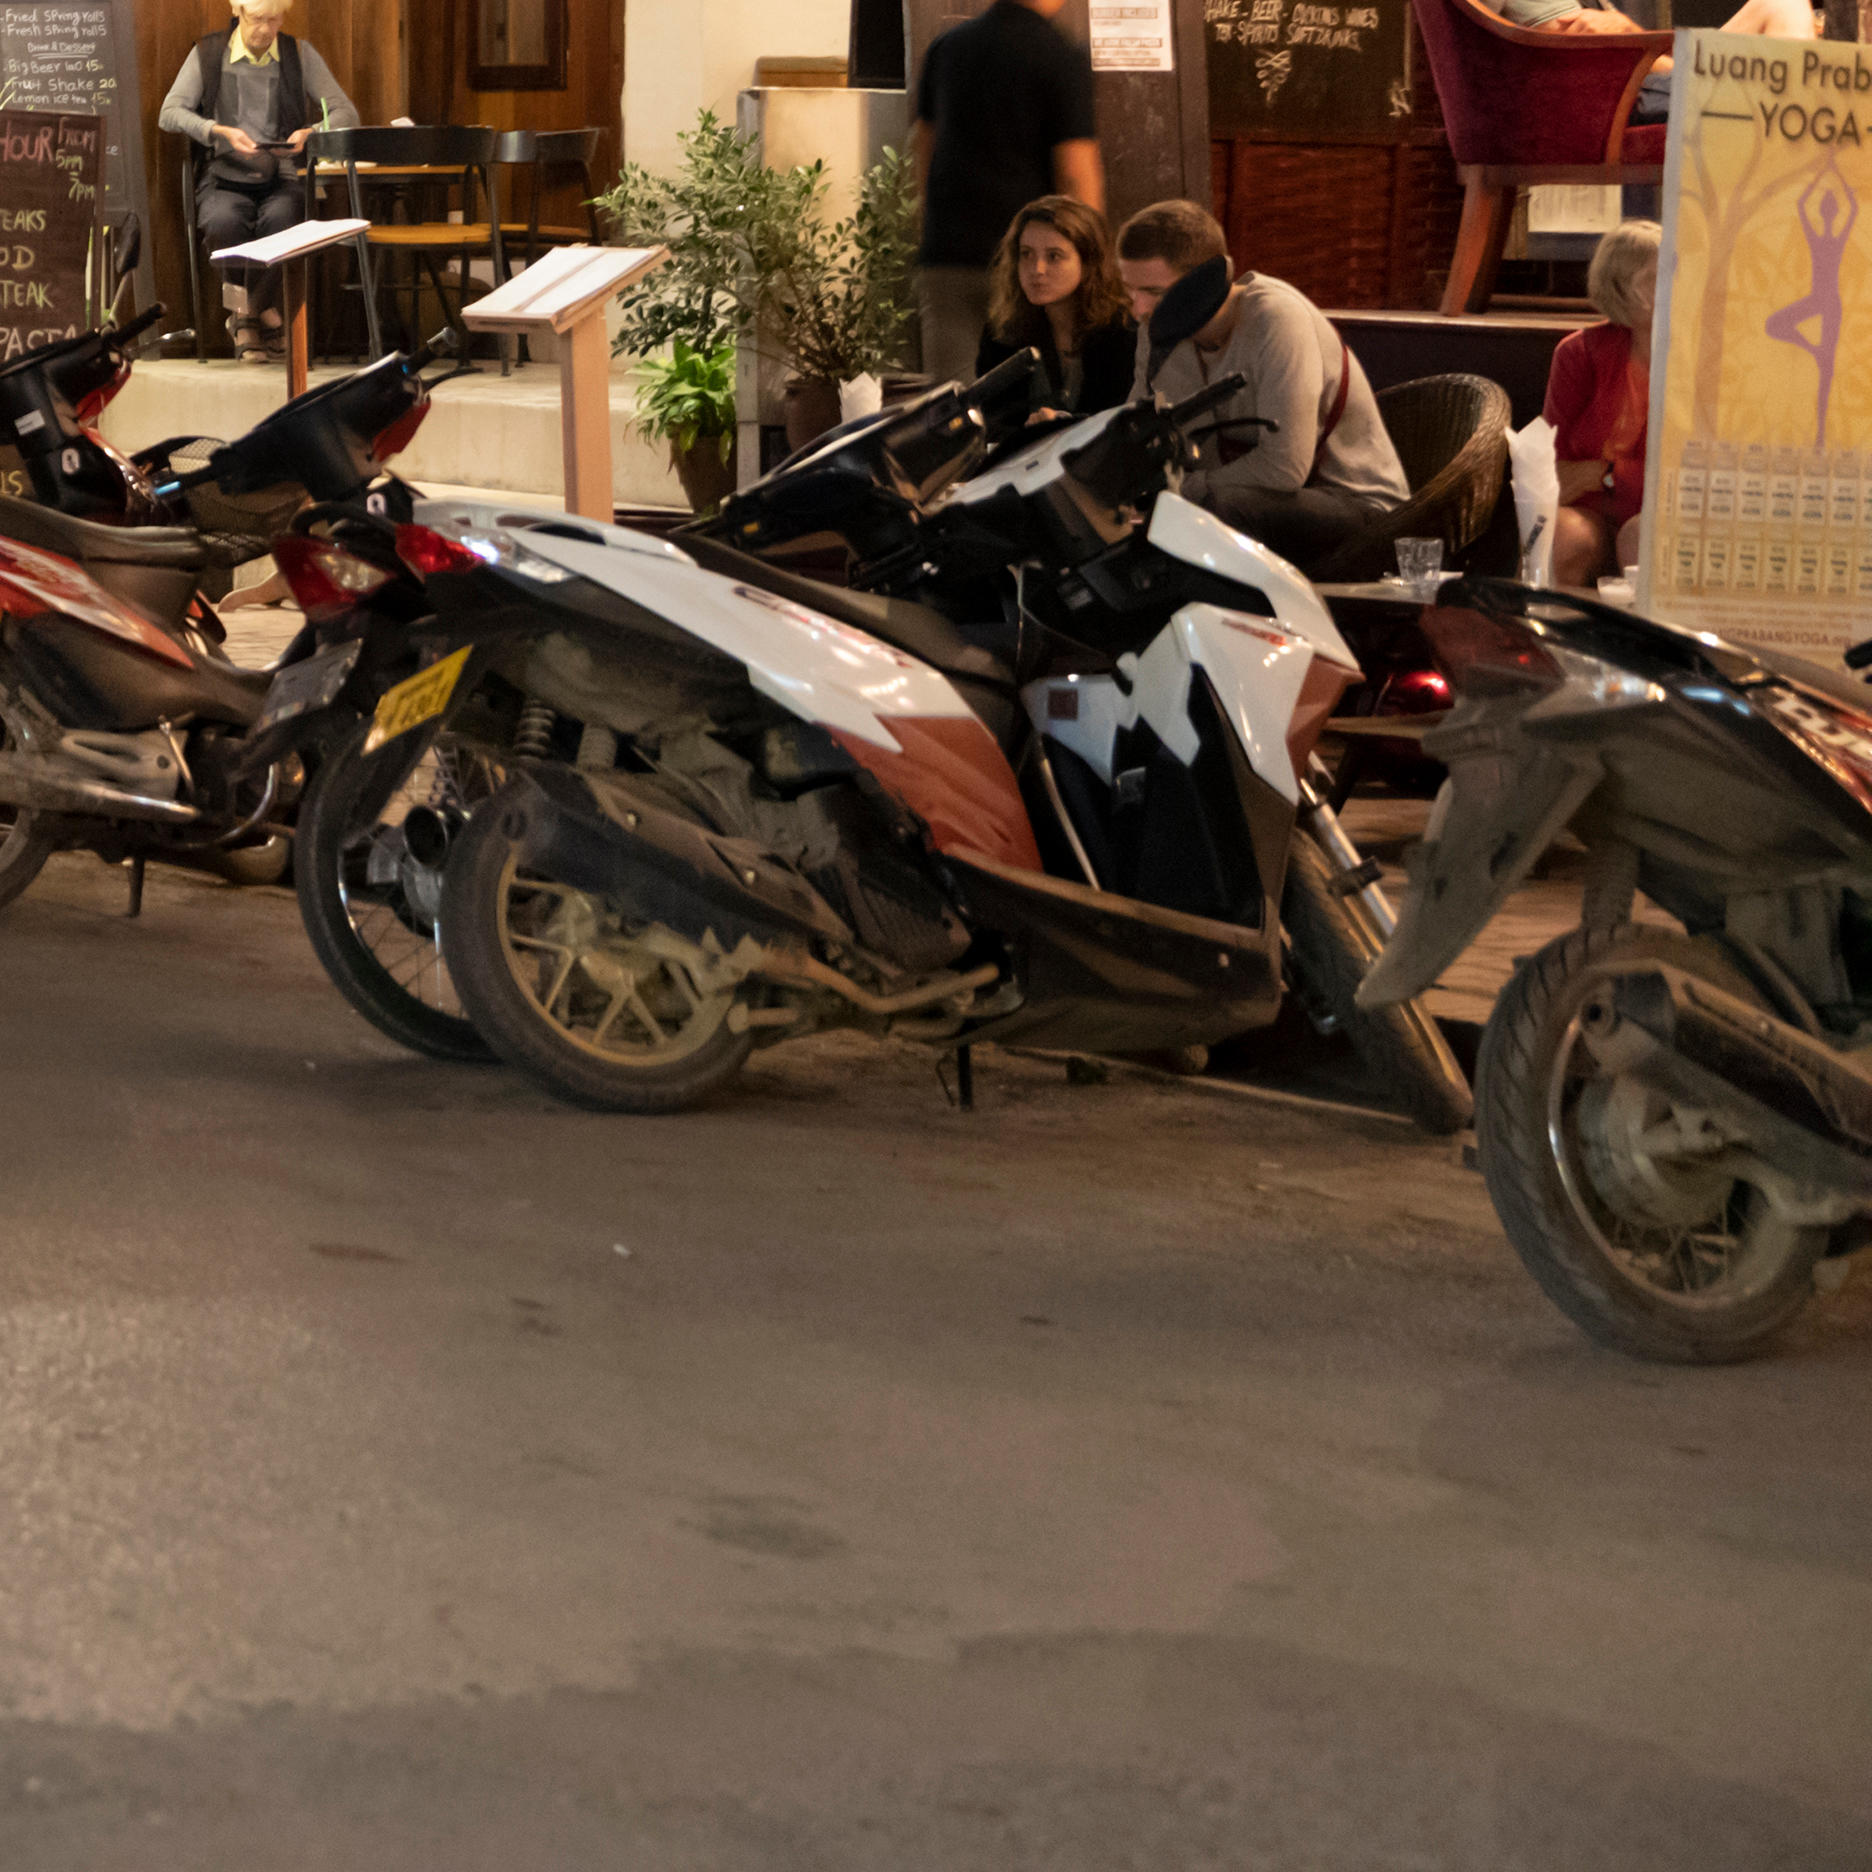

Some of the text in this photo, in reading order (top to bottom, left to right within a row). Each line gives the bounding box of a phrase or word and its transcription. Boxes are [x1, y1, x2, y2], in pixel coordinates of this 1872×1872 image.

[6, 8, 38, 23] Fried
[7, 24, 40, 36] Fresh
[8, 58, 29, 75] Big
[31, 60, 62, 73] Beer
[1694, 39, 1872, 95] Luang Prab
[11, 79, 41, 91] Fruit
[48, 79, 95, 92] Shake
[11, 91, 49, 104] Lemon
[53, 94, 68, 104] ice
[1759, 101, 1861, 147] YOGA
